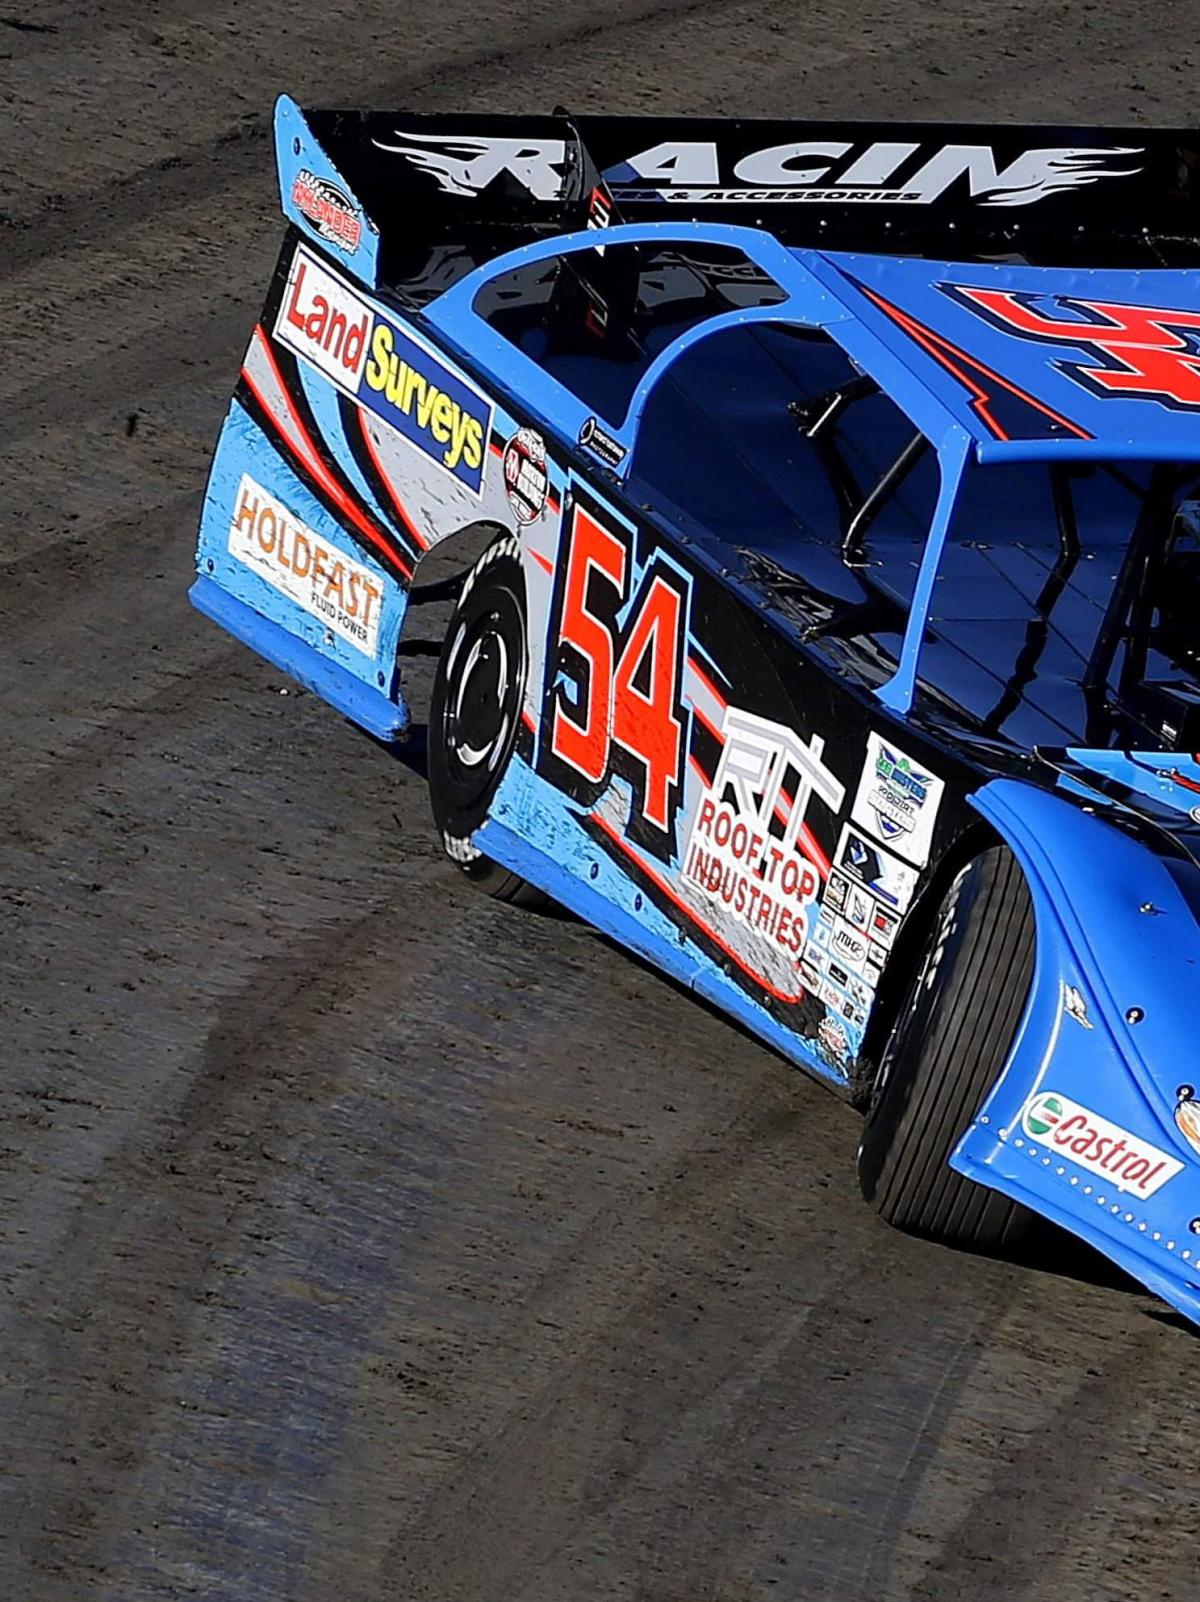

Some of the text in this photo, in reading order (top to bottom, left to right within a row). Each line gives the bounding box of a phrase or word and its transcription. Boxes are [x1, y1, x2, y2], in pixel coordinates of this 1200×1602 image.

[700, 191, 922, 201] ACCESSORIES
[285, 263, 484, 466] Land Surveys
[234, 488, 379, 627] HOLDFAST
[310, 590, 369, 644] FLUID POWER
[552, 503, 683, 834] 54
[686, 843, 804, 953] INDUSTRIES
[697, 797, 764, 867] ROOF
[769, 847, 815, 904] TOP
[1053, 1114, 1167, 1190] Castrol
